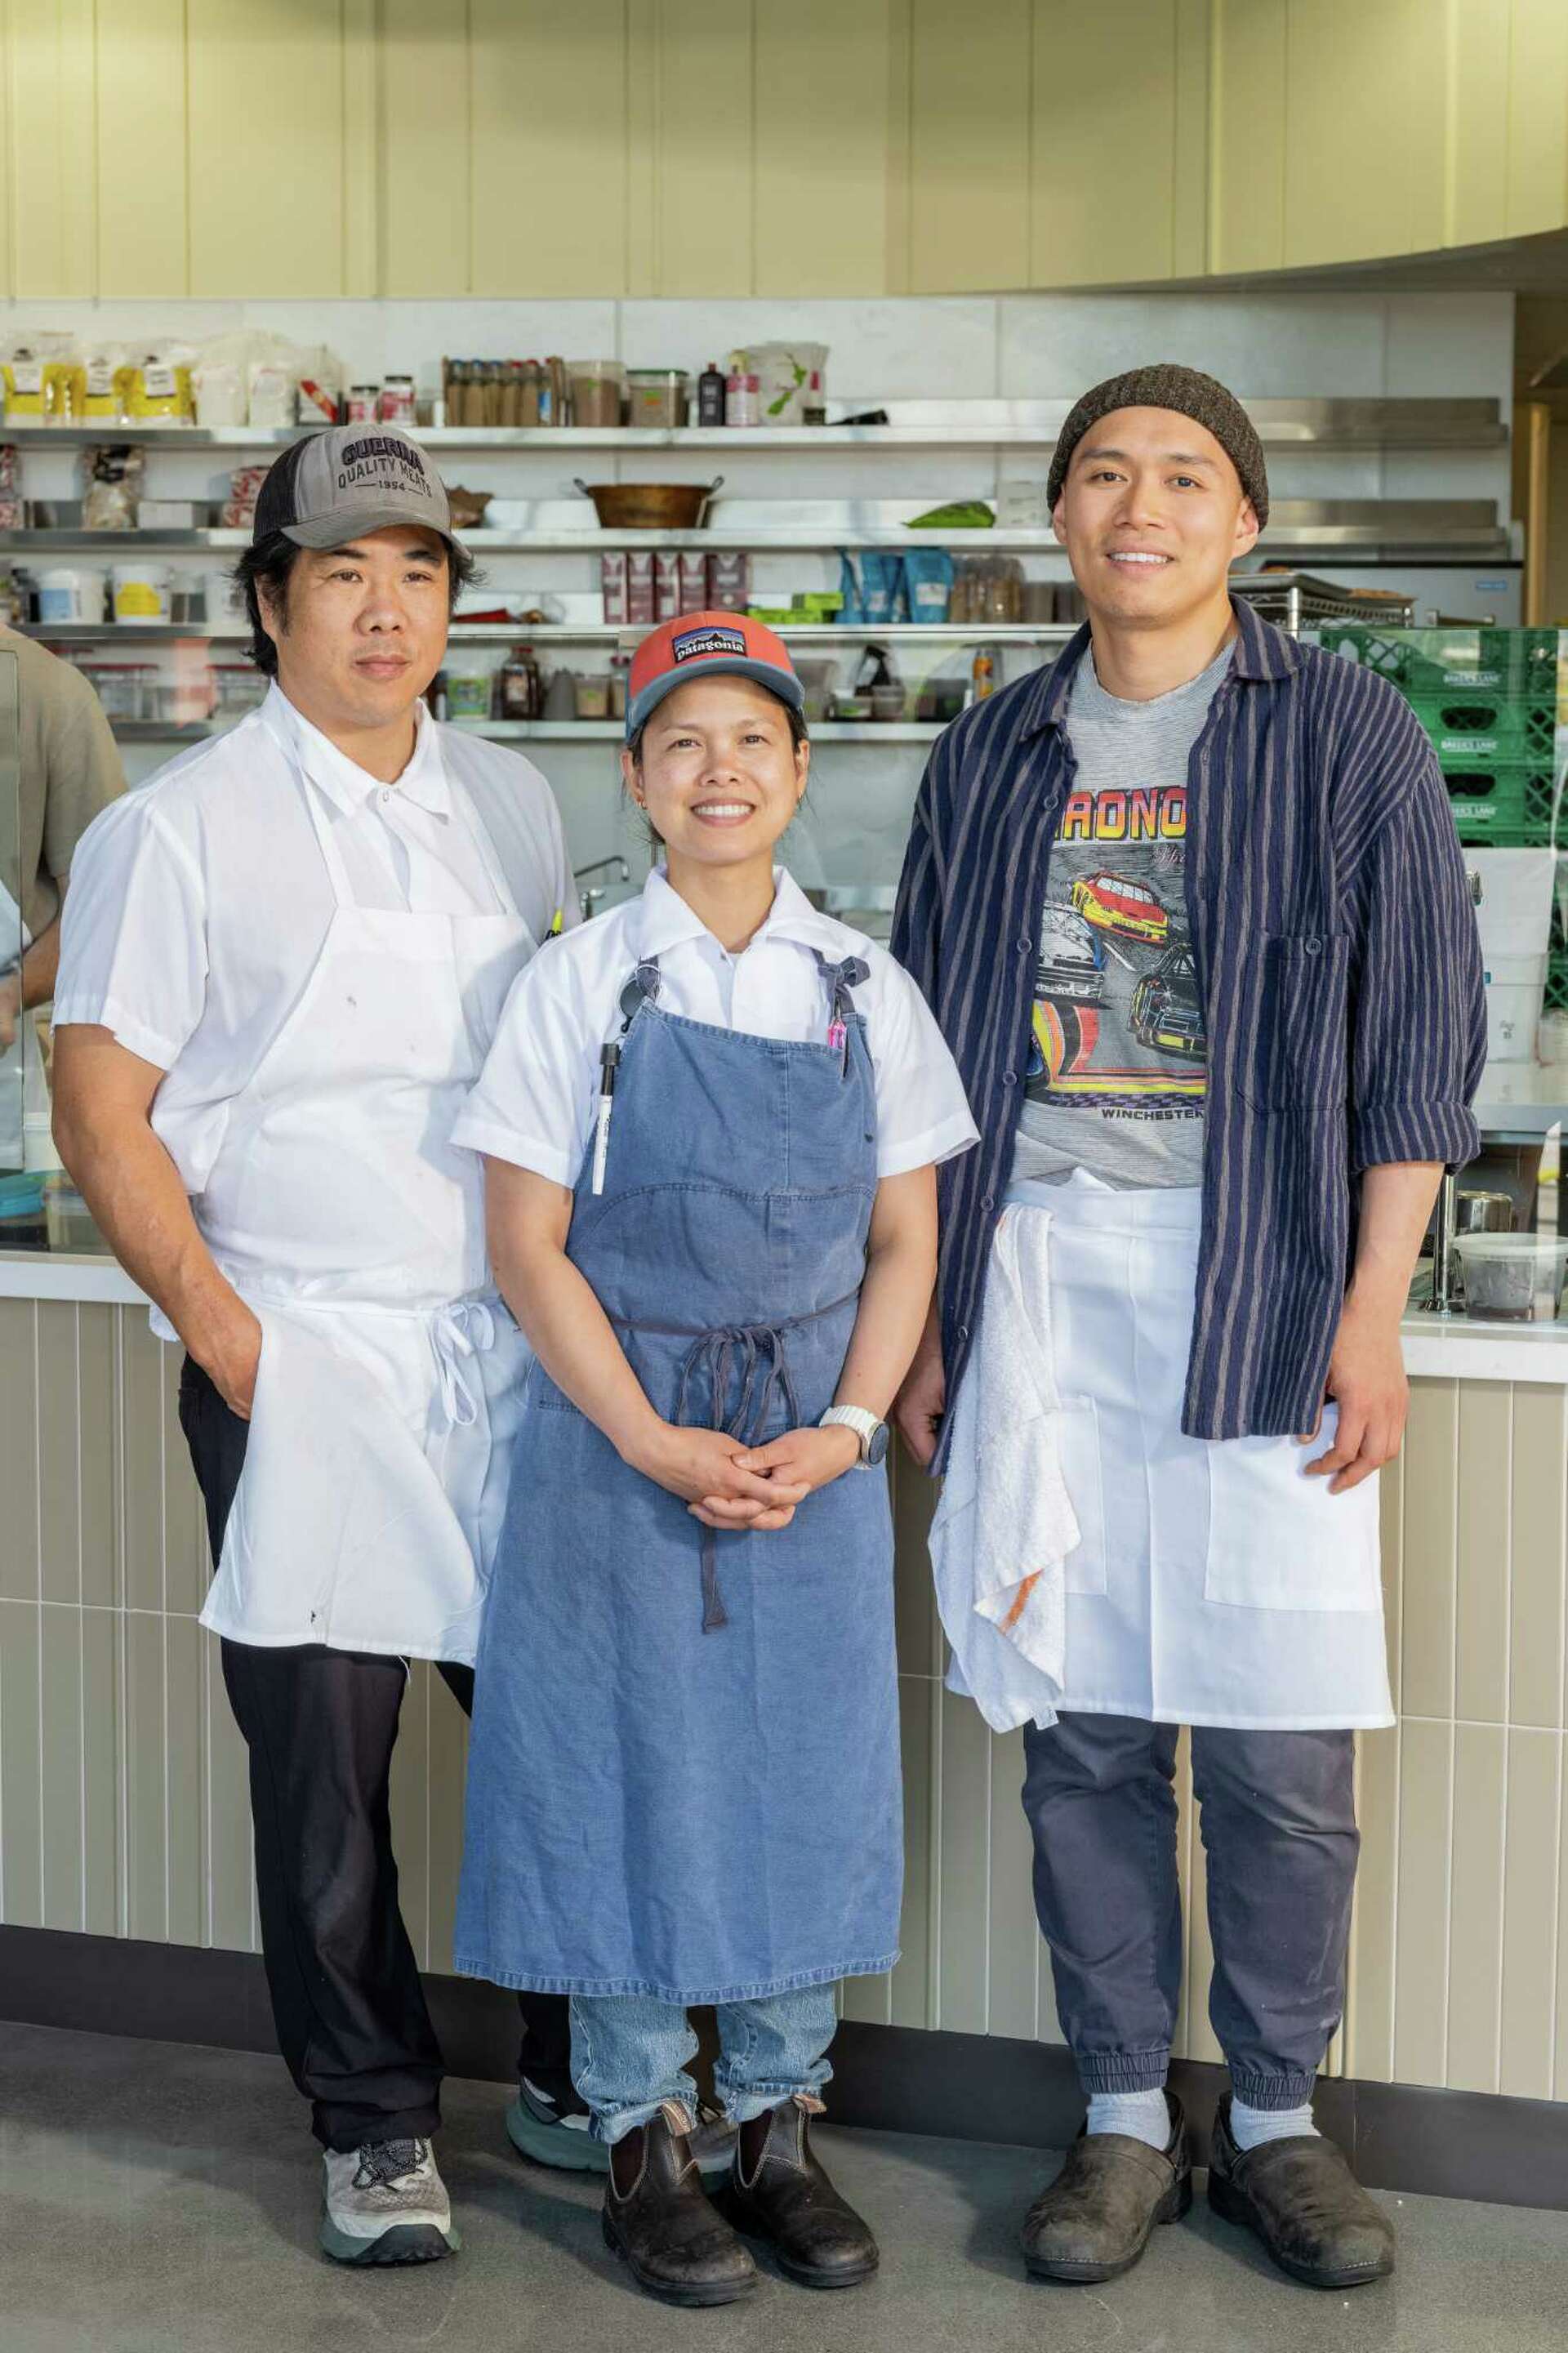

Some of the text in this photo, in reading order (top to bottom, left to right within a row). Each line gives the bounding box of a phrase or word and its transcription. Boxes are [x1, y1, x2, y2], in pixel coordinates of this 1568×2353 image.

[338, 457, 432, 498] QUALITY MEATS
[378, 480, 405, 491] 1954
[676, 641, 744, 662] patagonia
